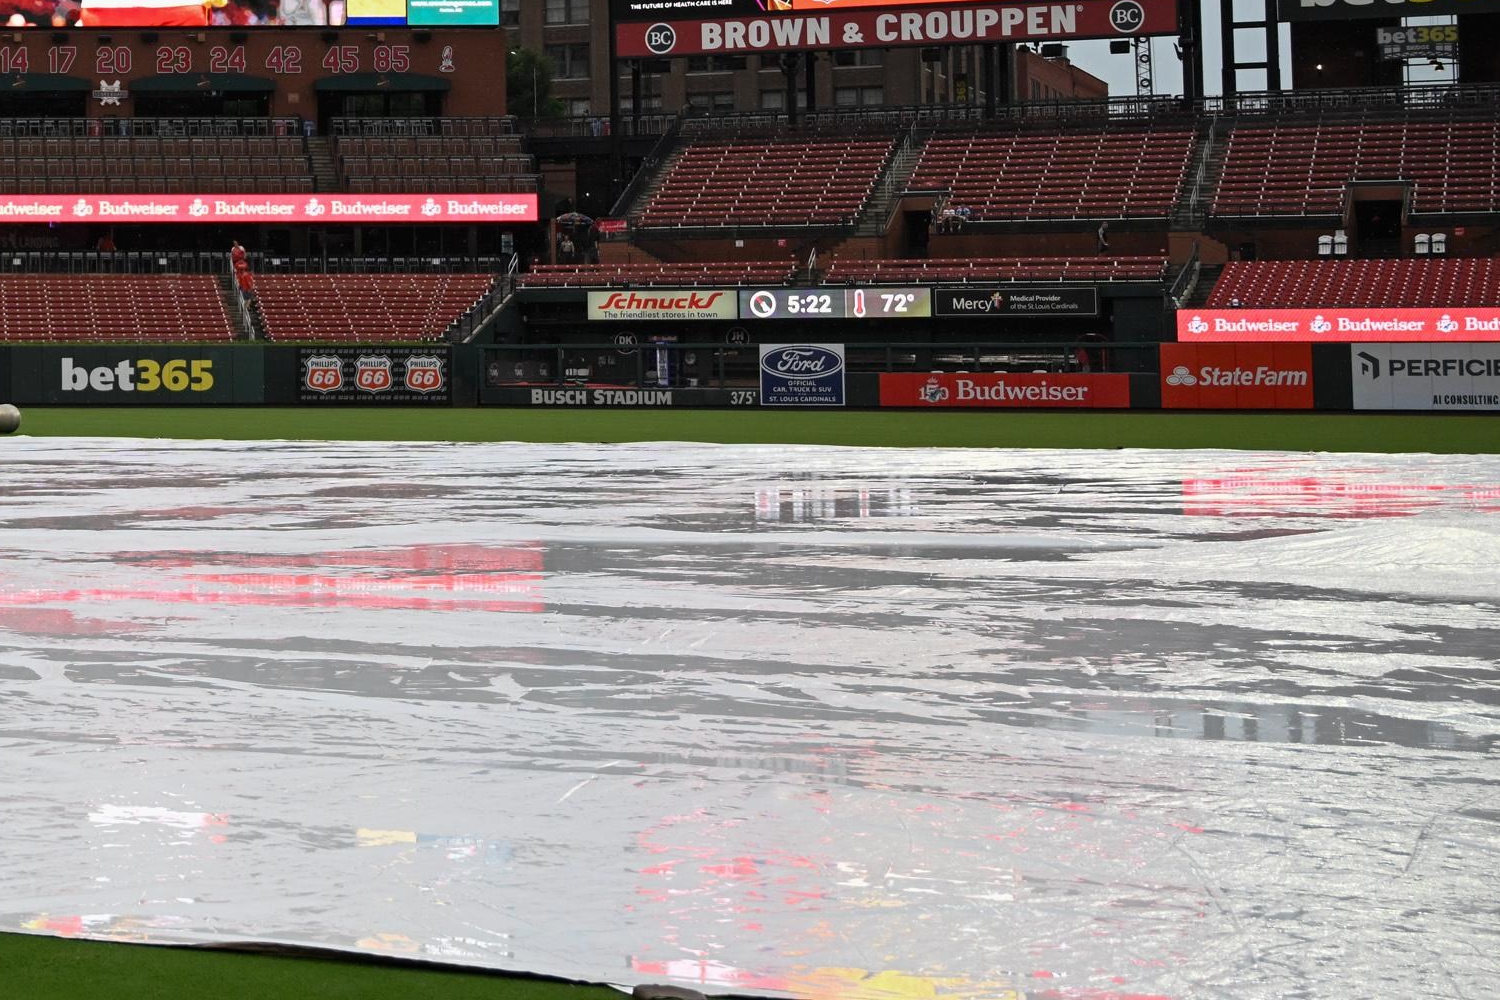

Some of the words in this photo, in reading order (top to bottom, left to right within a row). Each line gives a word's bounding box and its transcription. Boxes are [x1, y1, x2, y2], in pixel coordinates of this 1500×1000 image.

[1116, 9, 1139, 24] BC
[701, 17, 830, 50] BROWN
[842, 22, 865, 43] &
[876, 4, 1077, 42] CROUPPEN
[650, 32, 671, 45] BC
[1376, 25, 1458, 44] bet365
[0, 47, 28, 74] 14
[48, 47, 77, 74] 17
[96, 46, 132, 73] 20
[156, 46, 192, 73] 23
[209, 46, 246, 73] 24
[266, 46, 302, 73] 42
[322, 46, 359, 73] 45
[373, 46, 410, 73] 85
[99, 202, 179, 216] Budweiser
[215, 202, 294, 215] Budweiser
[331, 202, 411, 215] Budweiser
[447, 201, 527, 215] Budweiser
[787, 295, 832, 313] 5:22
[881, 294, 915, 312] 72°
[952, 298, 993, 312] Mercy
[603, 311, 618, 319] The
[620, 311, 660, 319] friendliest
[687, 311, 695, 319] in
[1215, 318, 1299, 332] Budweiser
[1338, 318, 1425, 331] Budweiser
[619, 335, 632, 345] DK
[732, 331, 744, 341] JH
[777, 350, 826, 371] Ford
[61, 357, 214, 392] bet365
[312, 371, 336, 385] 66
[361, 371, 385, 385] 66
[411, 371, 435, 385] 66
[531, 388, 587, 405] BUSCH
[593, 388, 672, 405] STADIUM
[956, 379, 1088, 401] Budweiser
[731, 391, 756, 405] 375'
[1433, 395, 1442, 405] AI
[1444, 395, 1499, 405] CONSULTING
